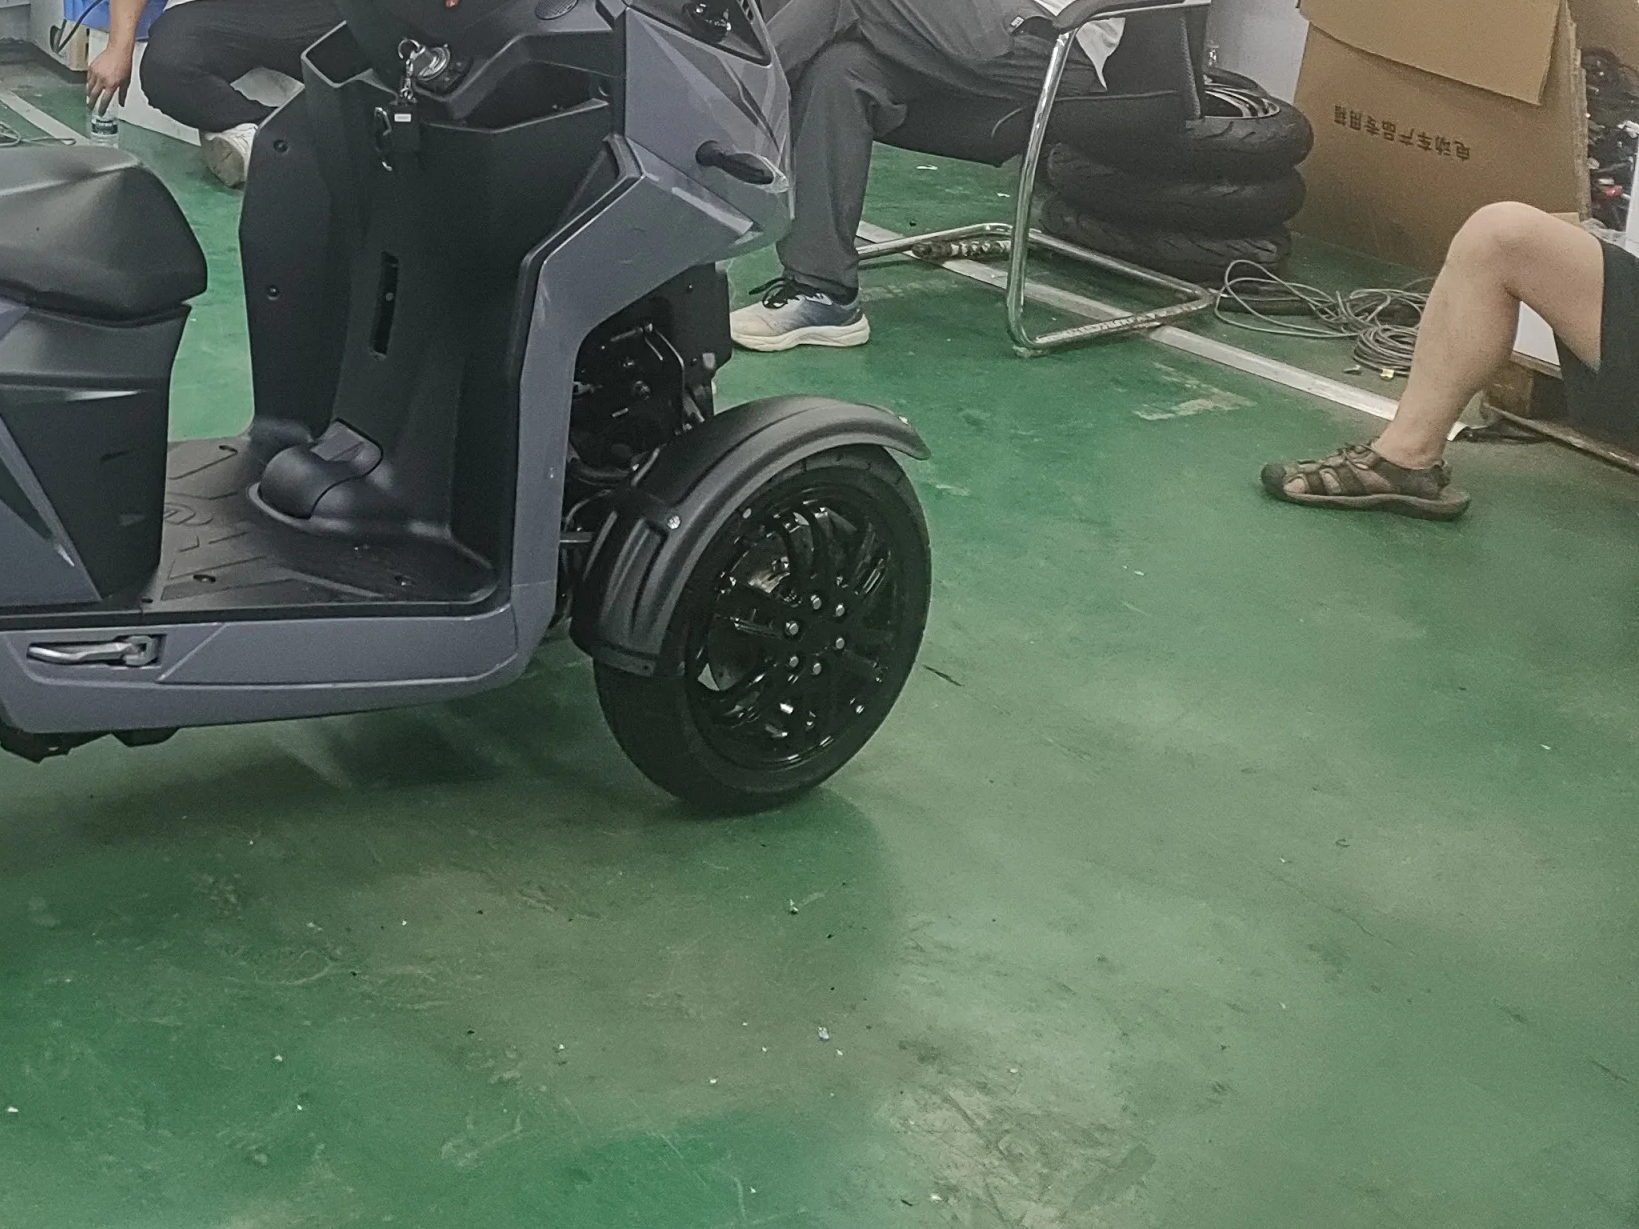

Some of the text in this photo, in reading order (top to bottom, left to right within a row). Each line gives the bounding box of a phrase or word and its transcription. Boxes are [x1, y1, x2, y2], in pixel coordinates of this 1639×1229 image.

[1333, 105, 1470, 160] 电动车产品专用箱
